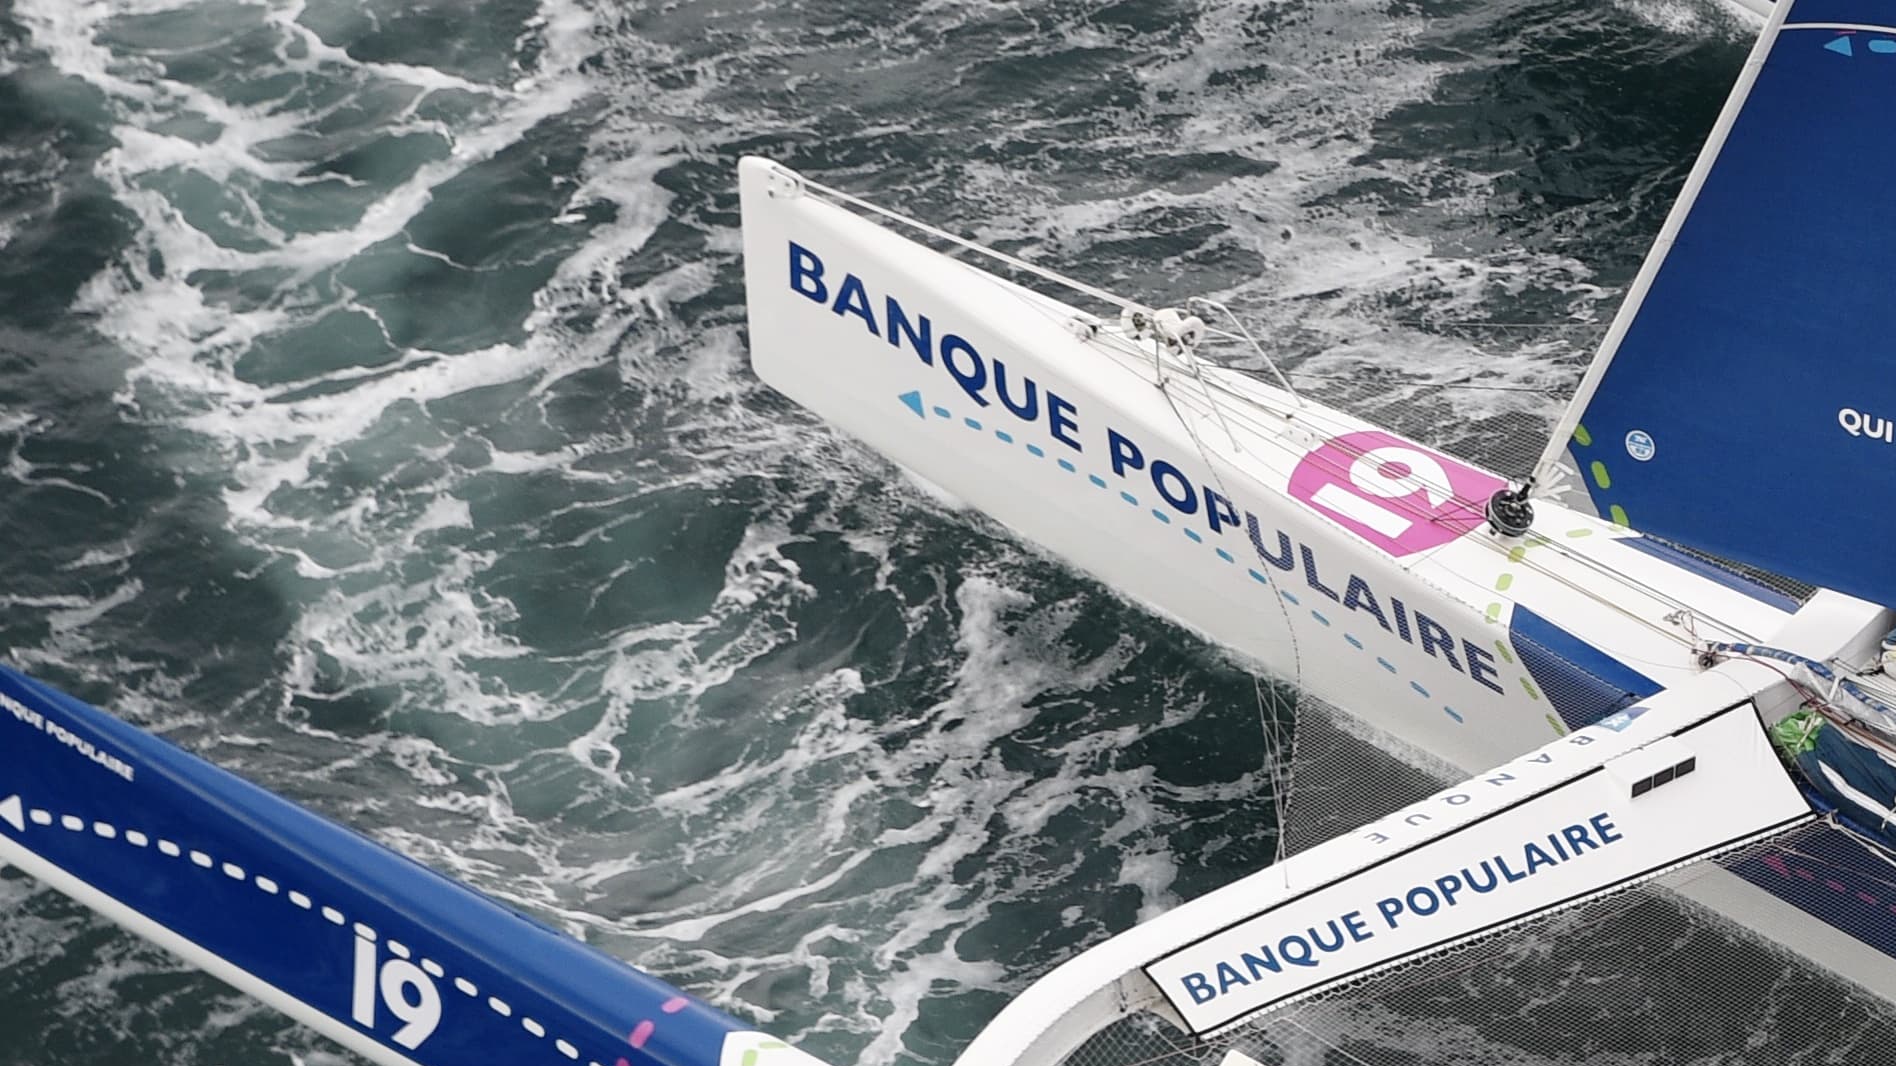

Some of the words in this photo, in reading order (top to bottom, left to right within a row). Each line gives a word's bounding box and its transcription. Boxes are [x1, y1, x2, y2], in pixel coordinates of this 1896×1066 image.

[788, 240, 1083, 452] BANQUE
[1109, 427, 1504, 696] POPULAIRE
[1838, 407, 1893, 443] QUI
[1309, 444, 1454, 539] 19
[0, 691, 45, 731] NQUE
[45, 719, 135, 782] POPULAIRE
[1364, 734, 1596, 845] BANQUE
[1180, 910, 1375, 1007] BANQUE
[1376, 811, 1624, 929] POPULAIRE
[352, 934, 443, 1051] 19
